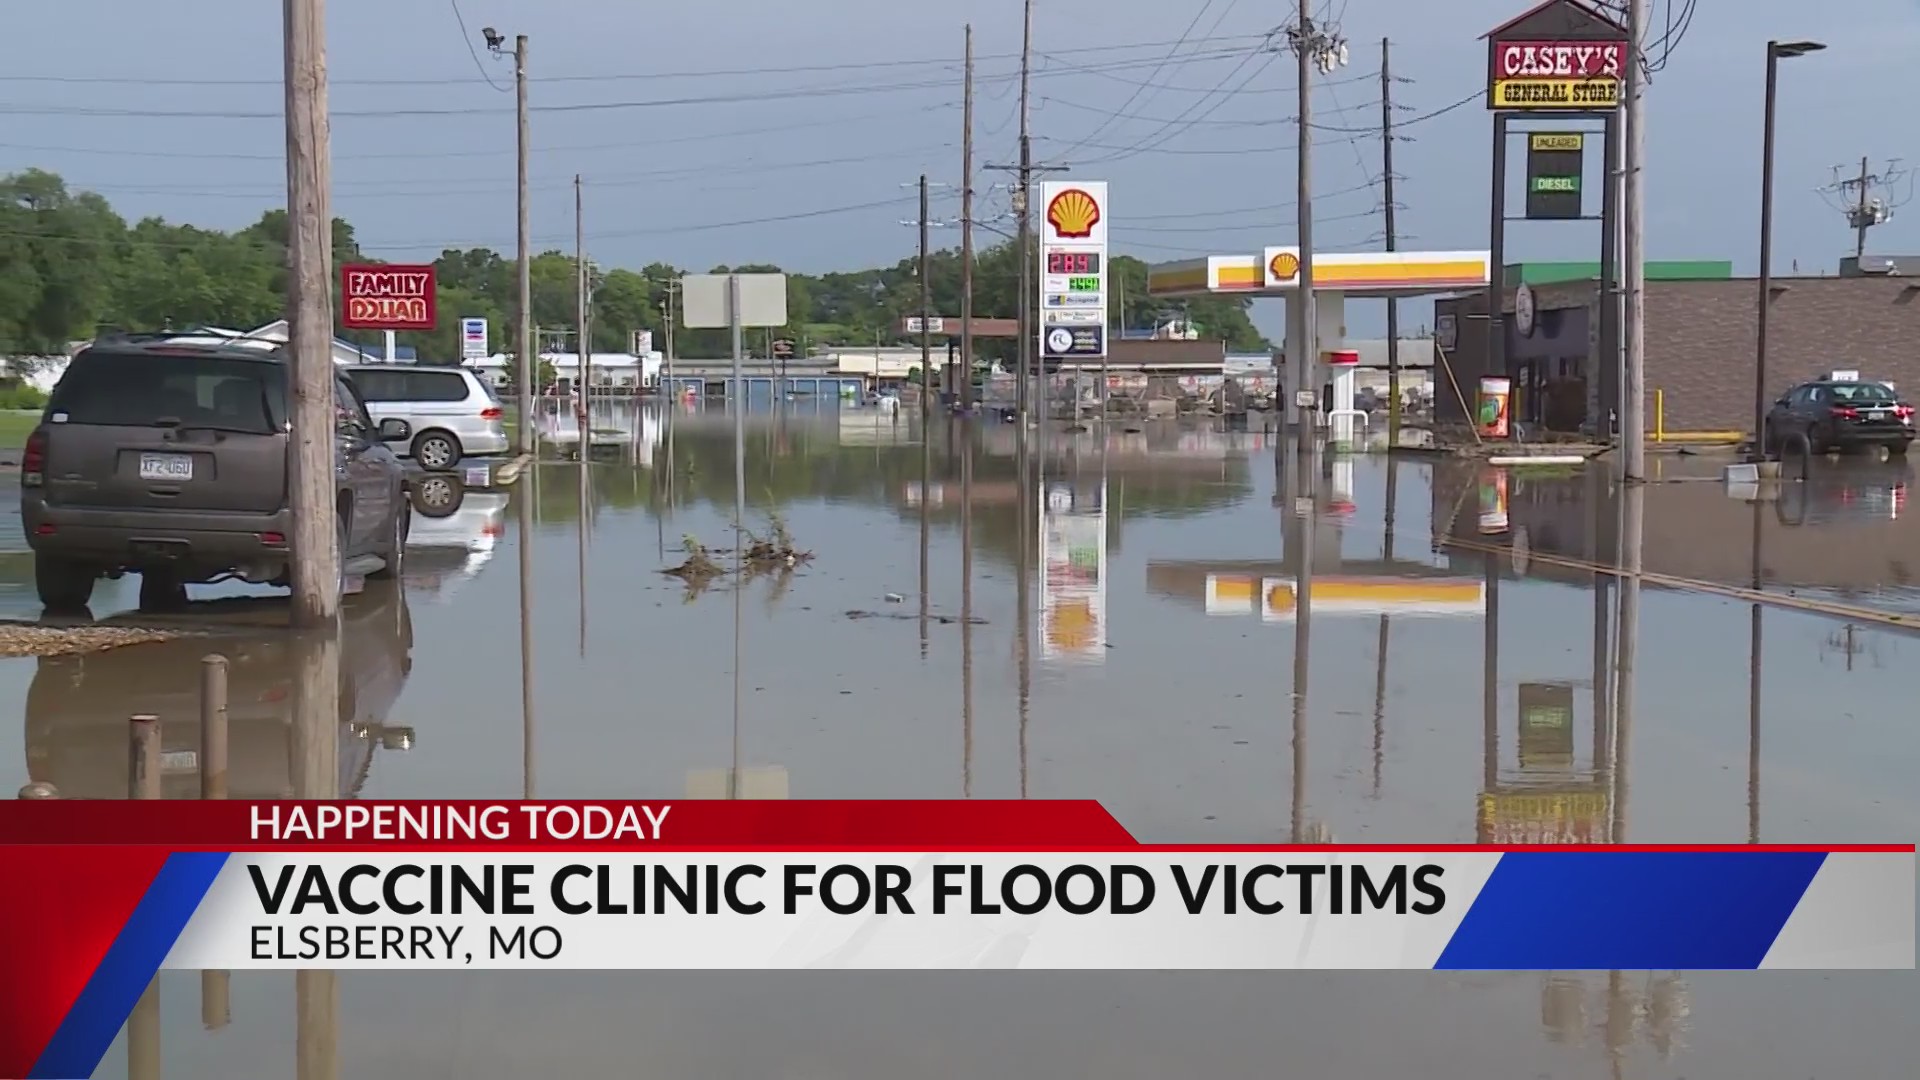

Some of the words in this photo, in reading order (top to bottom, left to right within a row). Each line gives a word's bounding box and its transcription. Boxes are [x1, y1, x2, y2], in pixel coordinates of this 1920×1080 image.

[1504, 46, 1619, 76] CASEY'S
[1504, 83, 1569, 102] GENERAL
[1572, 83, 1617, 102] STORE
[1537, 178, 1575, 190] DIESEL
[349, 272, 429, 296] FAMILY
[349, 297, 427, 322] DOLLAR
